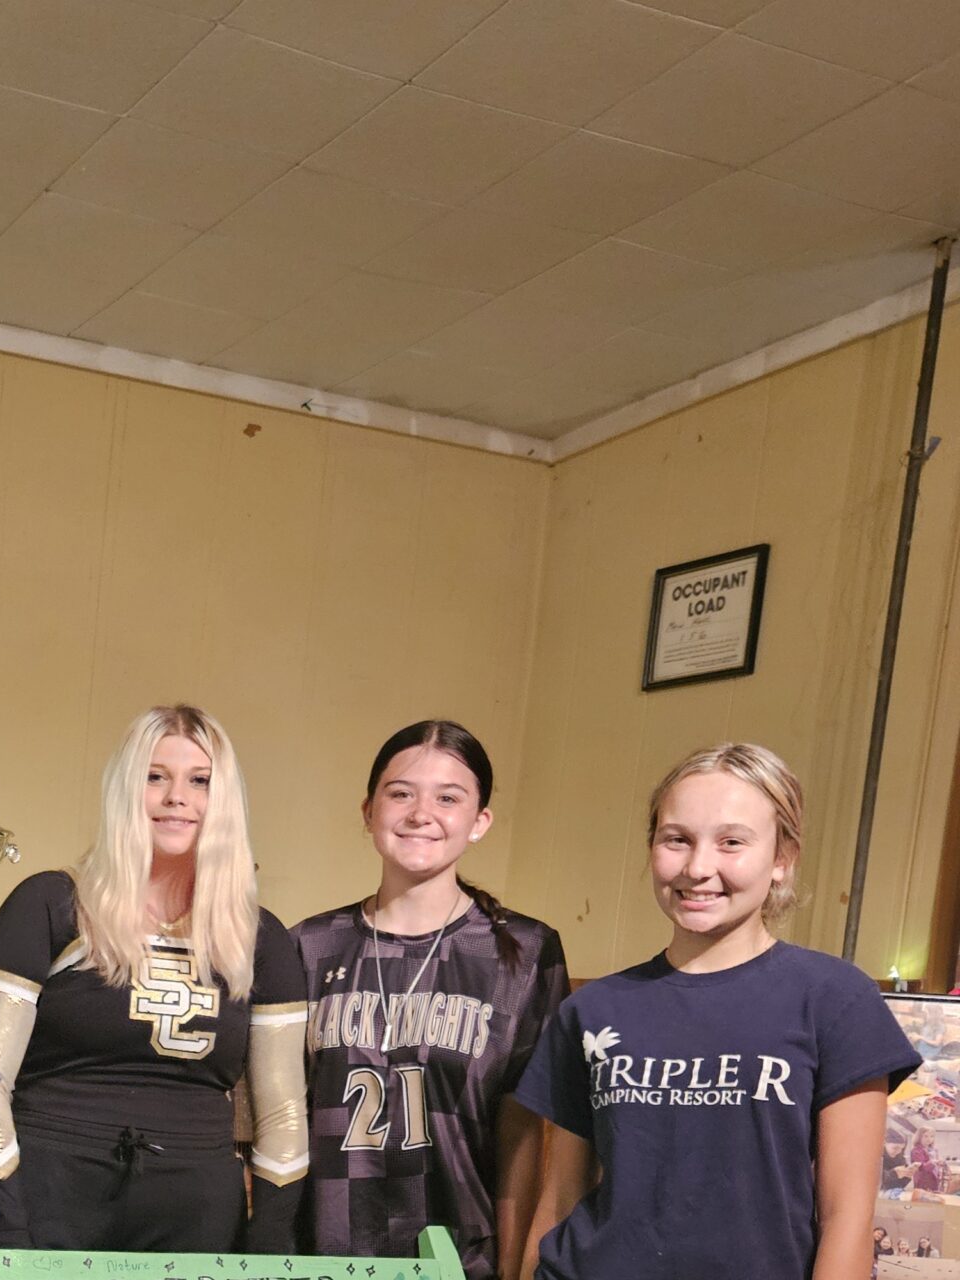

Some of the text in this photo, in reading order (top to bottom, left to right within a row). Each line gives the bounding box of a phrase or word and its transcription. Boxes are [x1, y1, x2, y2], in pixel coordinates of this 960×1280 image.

[672, 571, 748, 601] OCCUPANT
[688, 597, 726, 617] LOAD
[386, 991, 493, 1058] KNIGHTS
[592, 1054, 796, 1106] TRIPLE R
[341, 1067, 432, 1151] 21
[669, 1089, 746, 1106] RESORT
[106, 1259, 151, 1273] Nature
